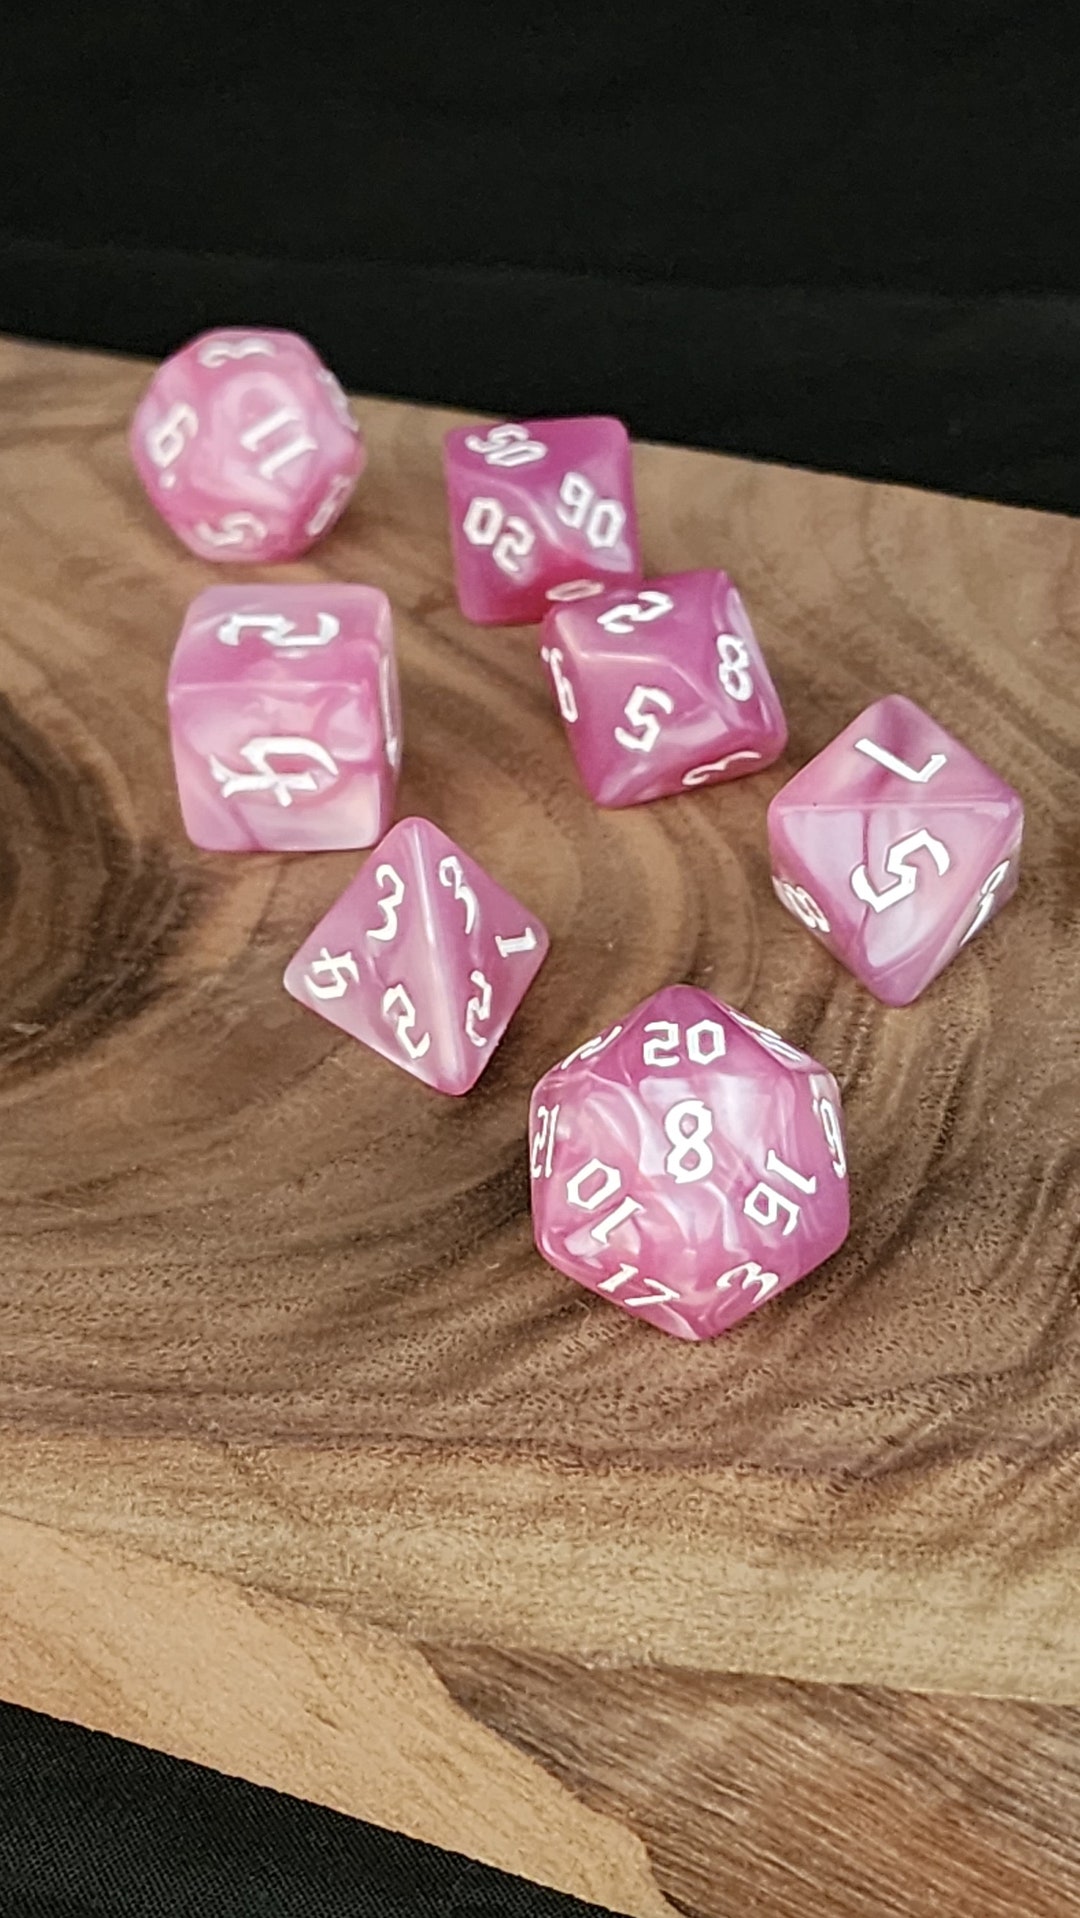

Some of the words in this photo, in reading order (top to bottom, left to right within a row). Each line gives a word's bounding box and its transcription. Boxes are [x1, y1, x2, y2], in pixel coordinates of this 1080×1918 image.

[240, 404, 317, 480] 11
[465, 423, 548, 467] 50
[463, 496, 535, 573] 20
[217, 611, 341, 647] 2
[597, 591, 674, 634] 2
[715, 633, 754, 702] 8
[614, 684, 675, 753] 5
[208, 736, 340, 808] 4
[366, 864, 405, 941] 3
[439, 855, 477, 935] 3
[850, 829, 951, 914] 5
[494, 927, 537, 958] 1
[783, 883, 831, 933] 8
[303, 947, 360, 999] 4
[383, 983, 430, 1059] 2
[465, 970, 492, 1047] 2
[643, 1019, 726, 1066] 20
[665, 1100, 714, 1184] 8
[566, 1157, 645, 1246] 10
[743, 1149, 817, 1237] 16
[597, 1262, 681, 1307] 17
[715, 1261, 779, 1304] 3
